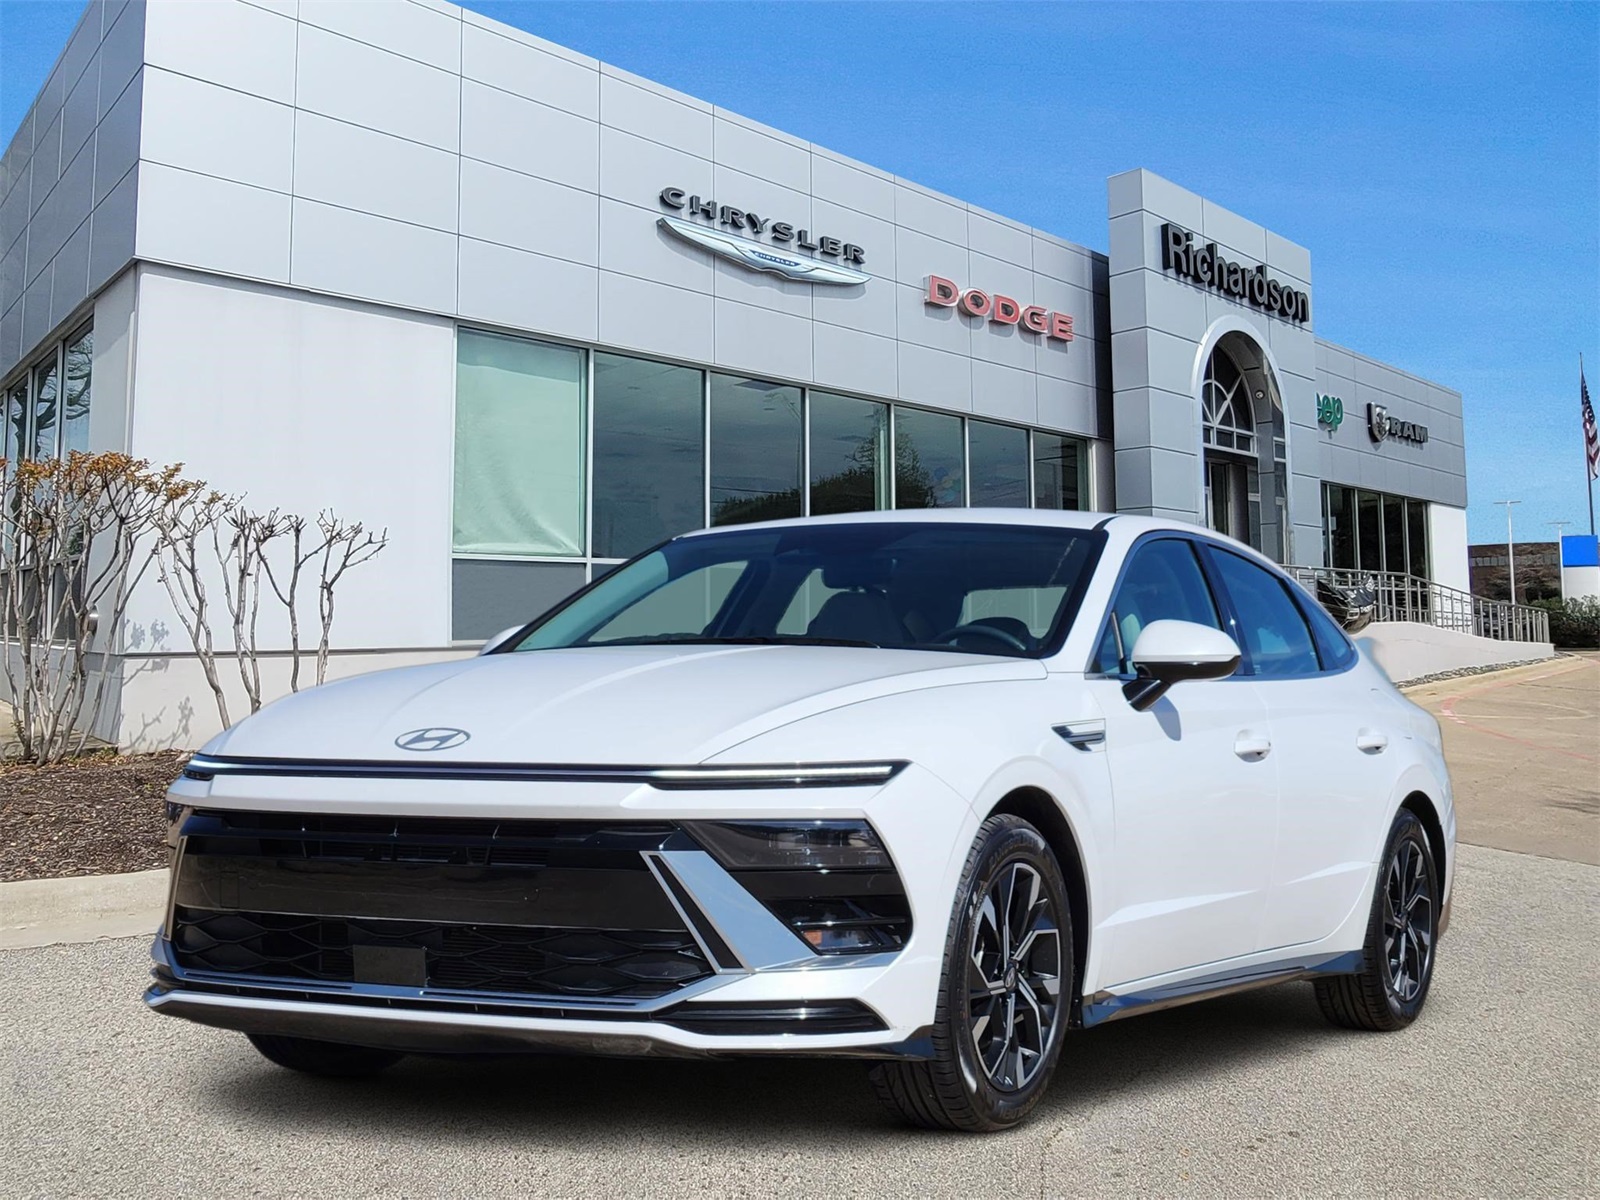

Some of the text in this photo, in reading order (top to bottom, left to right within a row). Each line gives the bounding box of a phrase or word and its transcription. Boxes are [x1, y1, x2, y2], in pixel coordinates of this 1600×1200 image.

[659, 186, 866, 264] CHRYSLER
[924, 275, 1073, 342] DODGE
[1161, 223, 1309, 323] Richardson
[1388, 416, 1428, 443] RAM
